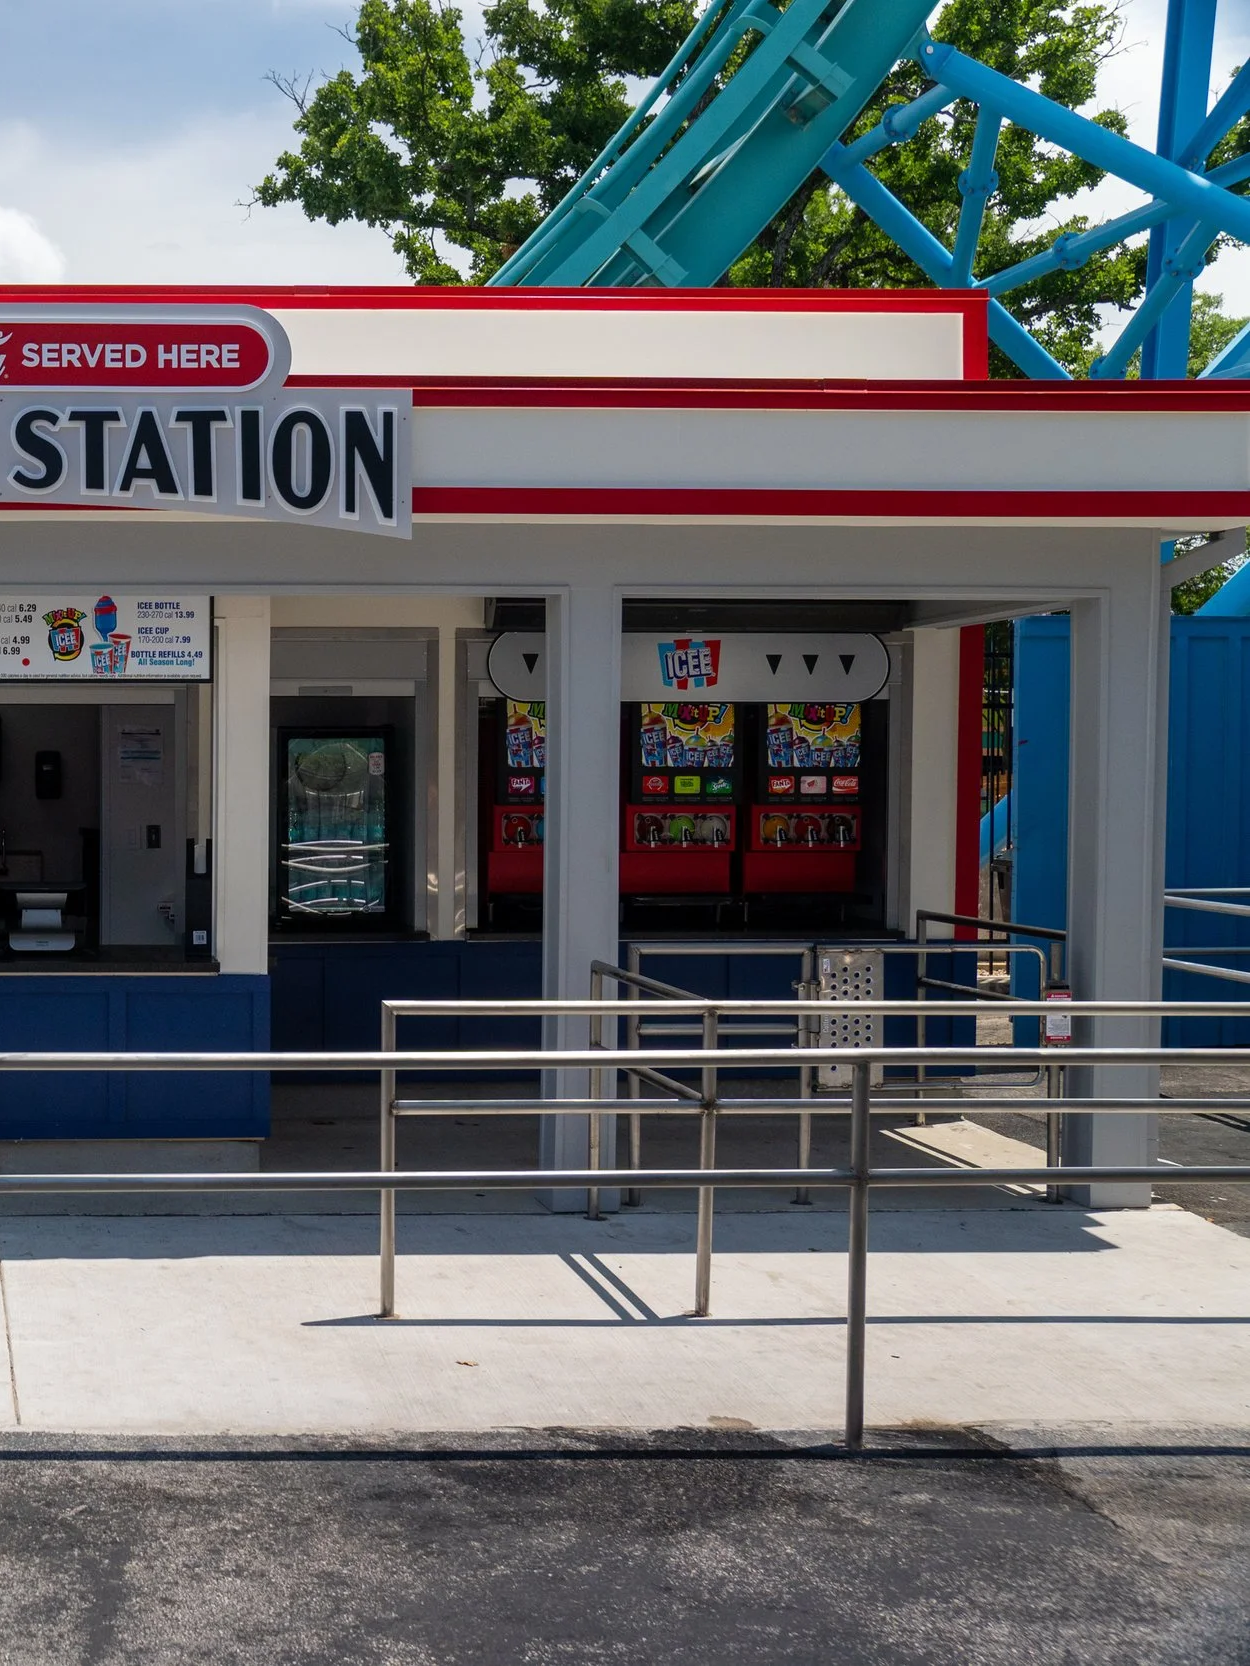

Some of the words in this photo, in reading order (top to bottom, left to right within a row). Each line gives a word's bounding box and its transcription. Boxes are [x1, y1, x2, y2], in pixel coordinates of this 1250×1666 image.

[21, 342, 147, 369] SERVED
[157, 342, 240, 368] HERE
[12, 409, 394, 520] STATION
[7, 603, 17, 612] cal
[18, 603, 37, 612] 6.29
[137, 602, 153, 610] ICEE
[154, 602, 181, 610] BOTTLE
[3, 614, 13, 623] cal
[14, 614, 33, 623] 5.49
[137, 611, 164, 619] 230-270
[164, 611, 174, 619] cal
[175, 611, 195, 619] 13.99
[137, 627, 153, 635] ICEE
[155, 627, 170, 635] CUP
[0, 635, 10, 644] cal
[12, 635, 30, 644] 4.99
[54, 632, 77, 647] ICEE
[138, 636, 164, 644] 170-200
[165, 636, 174, 644] cal
[175, 636, 191, 644] 7.99
[2, 646, 21, 655] 6.99
[149, 658, 174, 666] Season
[175, 659, 195, 667] Long!
[665, 646, 713, 681] ICEE
[508, 732, 531, 745] ICEE
[642, 730, 665, 745] ICEE
[768, 732, 791, 746] ICEE
[685, 751, 705, 761] ICEE
[812, 752, 831, 762] ICEE
